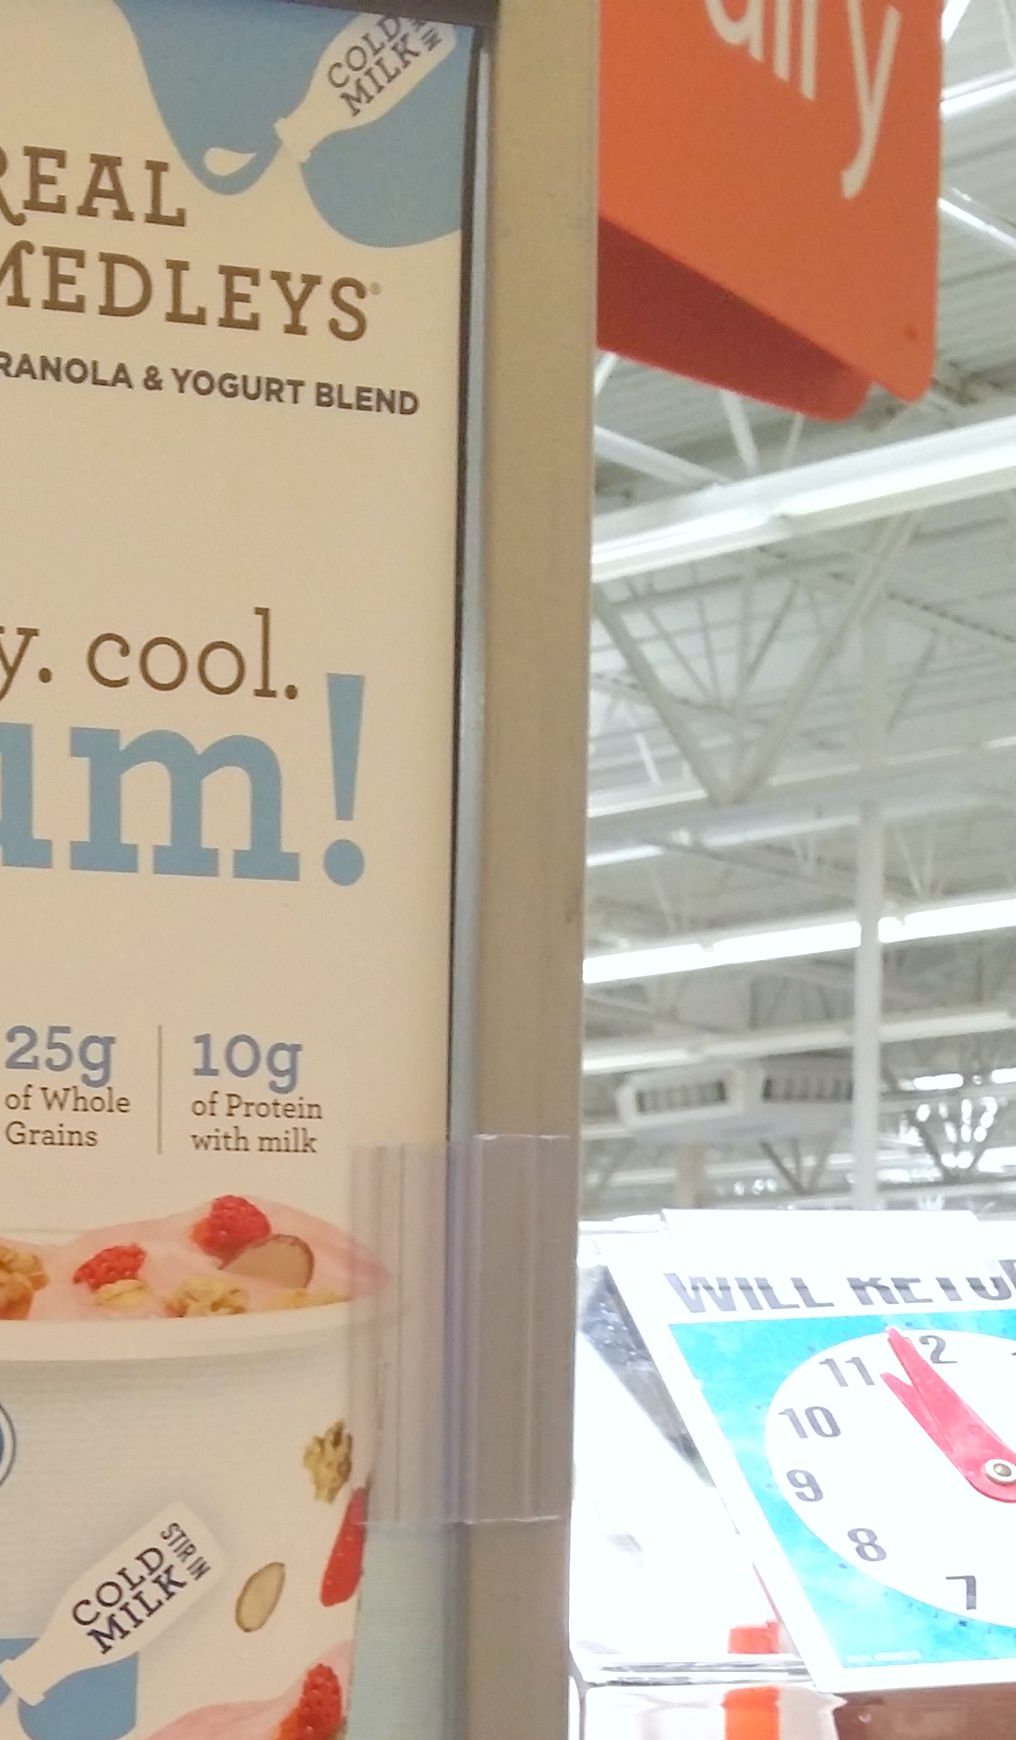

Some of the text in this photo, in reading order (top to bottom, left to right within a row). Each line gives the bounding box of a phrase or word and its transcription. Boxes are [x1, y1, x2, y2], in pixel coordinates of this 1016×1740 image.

[327, 14, 402, 88] COLD
[340, 32, 420, 117] MILK
[143, 365, 164, 391] &
[171, 367, 305, 404] YOGURT
[315, 381, 420, 415] BLEND
[85, 606, 299, 700] cool.
[5, 1025, 303, 1094] 25g 10g
[4, 1084, 132, 1114] of Whole
[191, 1091, 324, 1120] of Protein
[4, 1120, 99, 1147] Grains
[191, 1125, 318, 1154] with milk
[664, 1272, 834, 1313] WILL
[819, 1355, 876, 1388] 11
[779, 1406, 841, 1439] 10
[786, 1468, 824, 1502] 9
[160, 1522, 211, 1581] STIR IN
[847, 1527, 887, 1562] 8
[72, 1547, 165, 1626] COLD
[945, 1575, 977, 1610] 7
[86, 1564, 188, 1655] MILK
